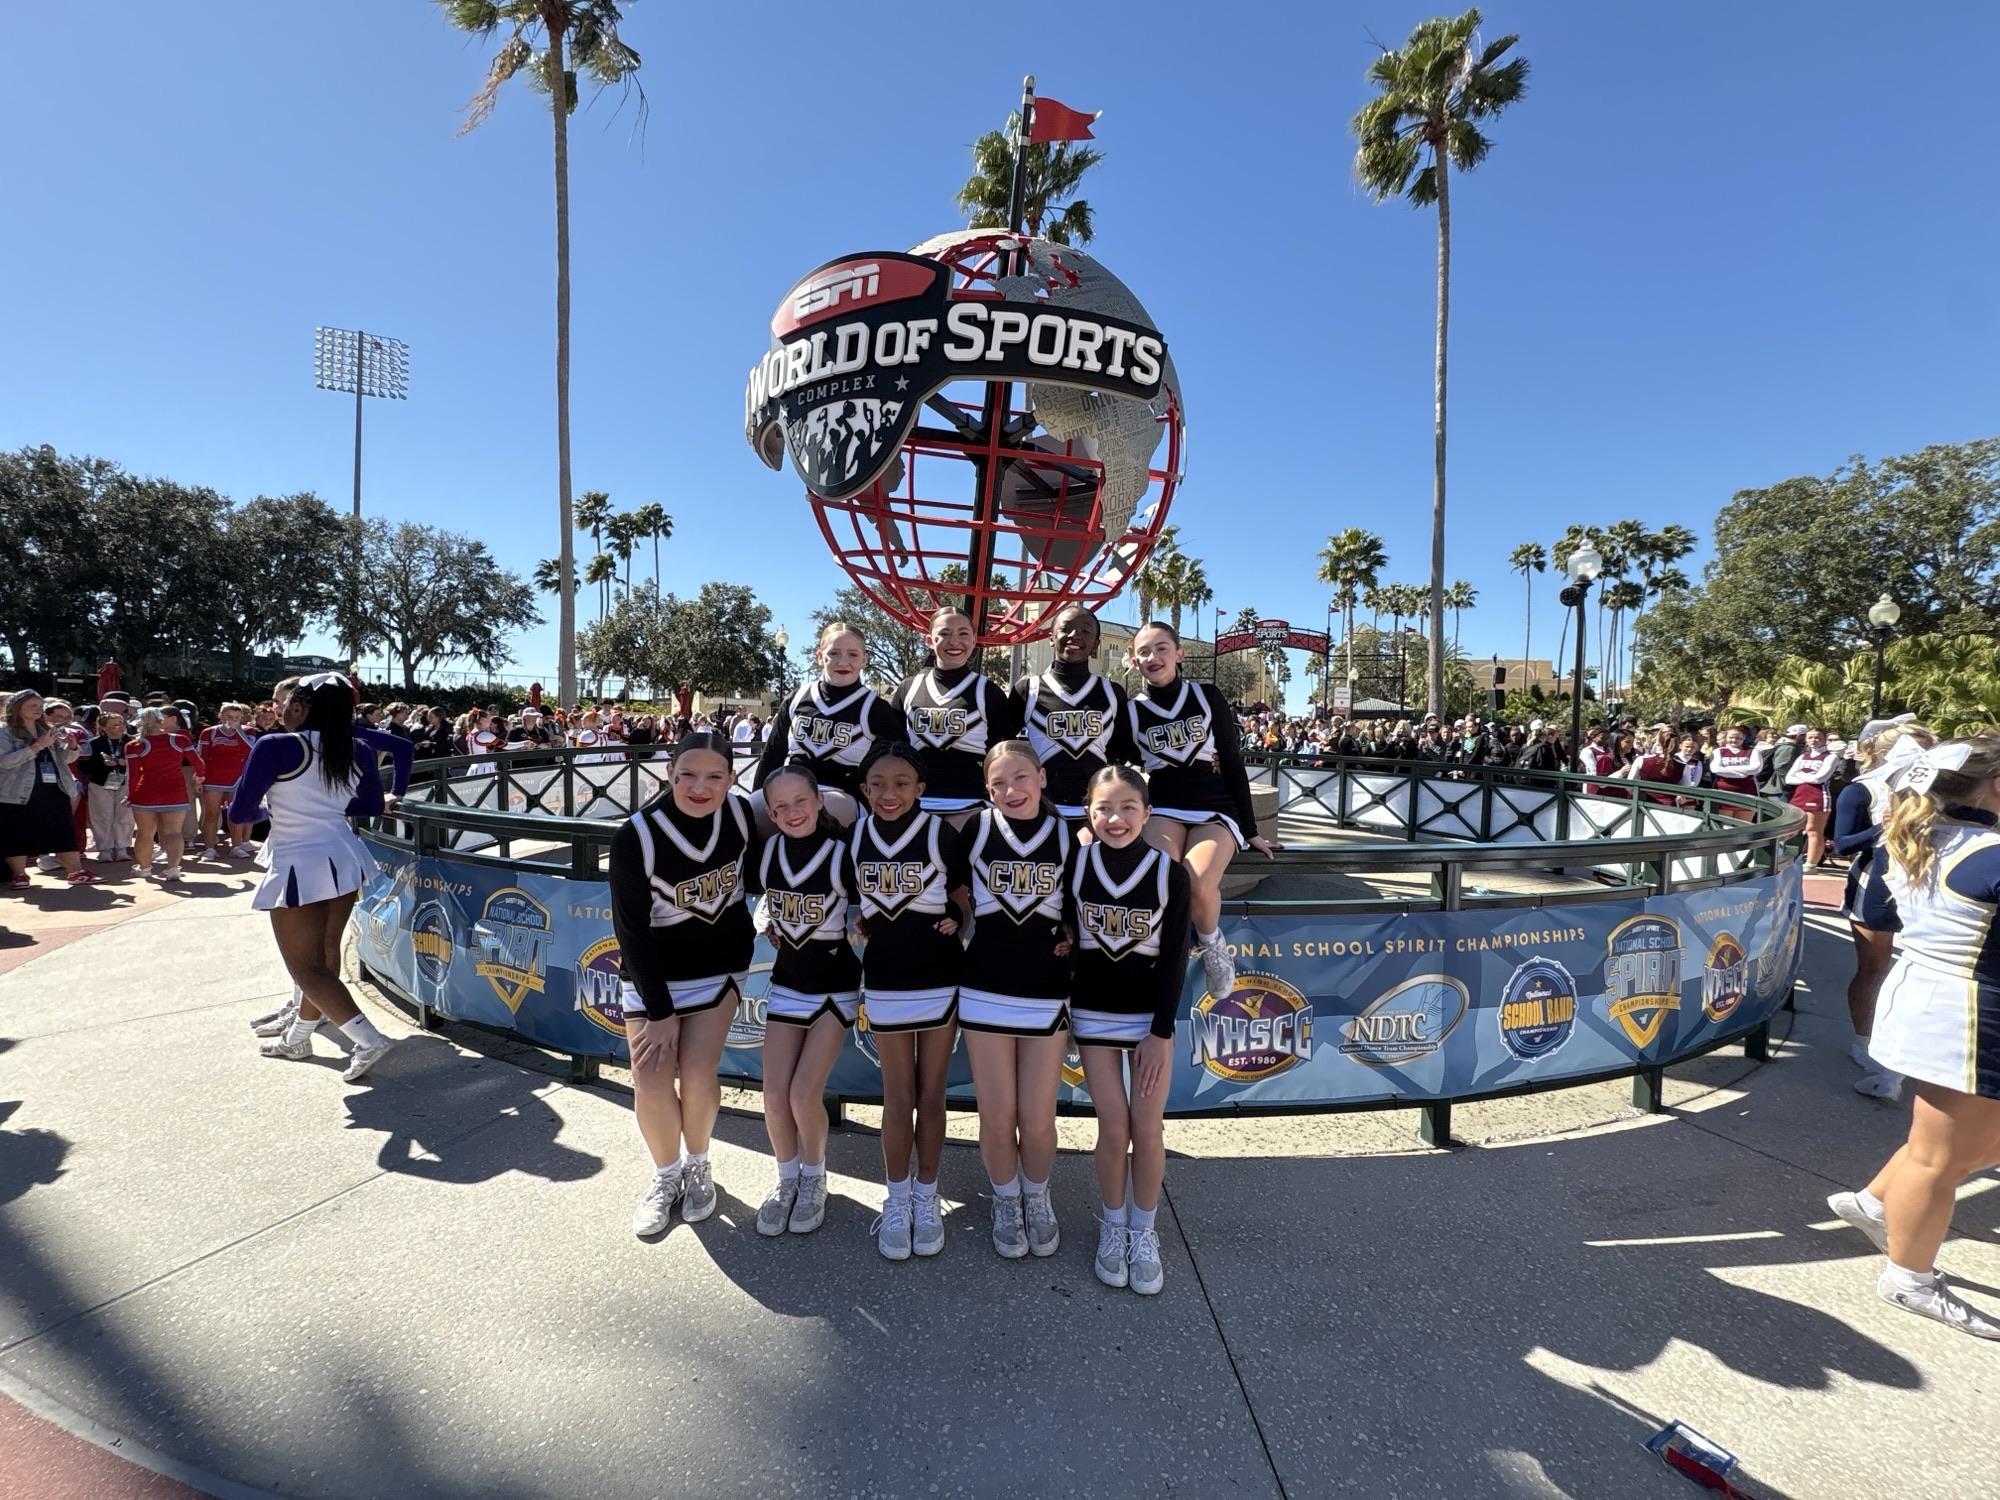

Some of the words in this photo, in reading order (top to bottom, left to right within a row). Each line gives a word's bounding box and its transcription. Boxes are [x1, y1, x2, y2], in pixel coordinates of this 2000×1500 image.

[793, 263, 880, 320] ESPN
[746, 321, 870, 416] WORLD
[874, 319, 939, 367] OF
[943, 302, 1163, 386] SPORTS
[797, 374, 877, 406] COMPLEX
[793, 715, 853, 747] CMS
[912, 708, 968, 736] CMS
[1046, 710, 1103, 739] CMS
[1146, 714, 1207, 753] CMS
[674, 860, 738, 909] CMS
[857, 862, 924, 894] CMS
[988, 860, 1057, 896] CMS
[765, 888, 826, 926] CMS
[1082, 902, 1152, 939] CMS
[470, 918, 555, 977] SPIRIT
[1226, 943, 1283, 957] ONAL
[1293, 941, 1375, 957] SCHOOL
[1385, 938, 1446, 953] SPIRIT
[1456, 927, 1585, 952] CHAMPIONSHIPS
[1604, 948, 1687, 1007] SPIRIT
[733, 996, 768, 1025] TC
[1351, 1013, 1427, 1042] NDTC
[1503, 999, 1545, 1030] SCHOOL
[1546, 996, 1574, 1025] BAND
[1190, 1005, 1313, 1067] NHSCC
[1228, 1057, 1249, 1066] EST.
[1252, 1056, 1277, 1065] 1980
